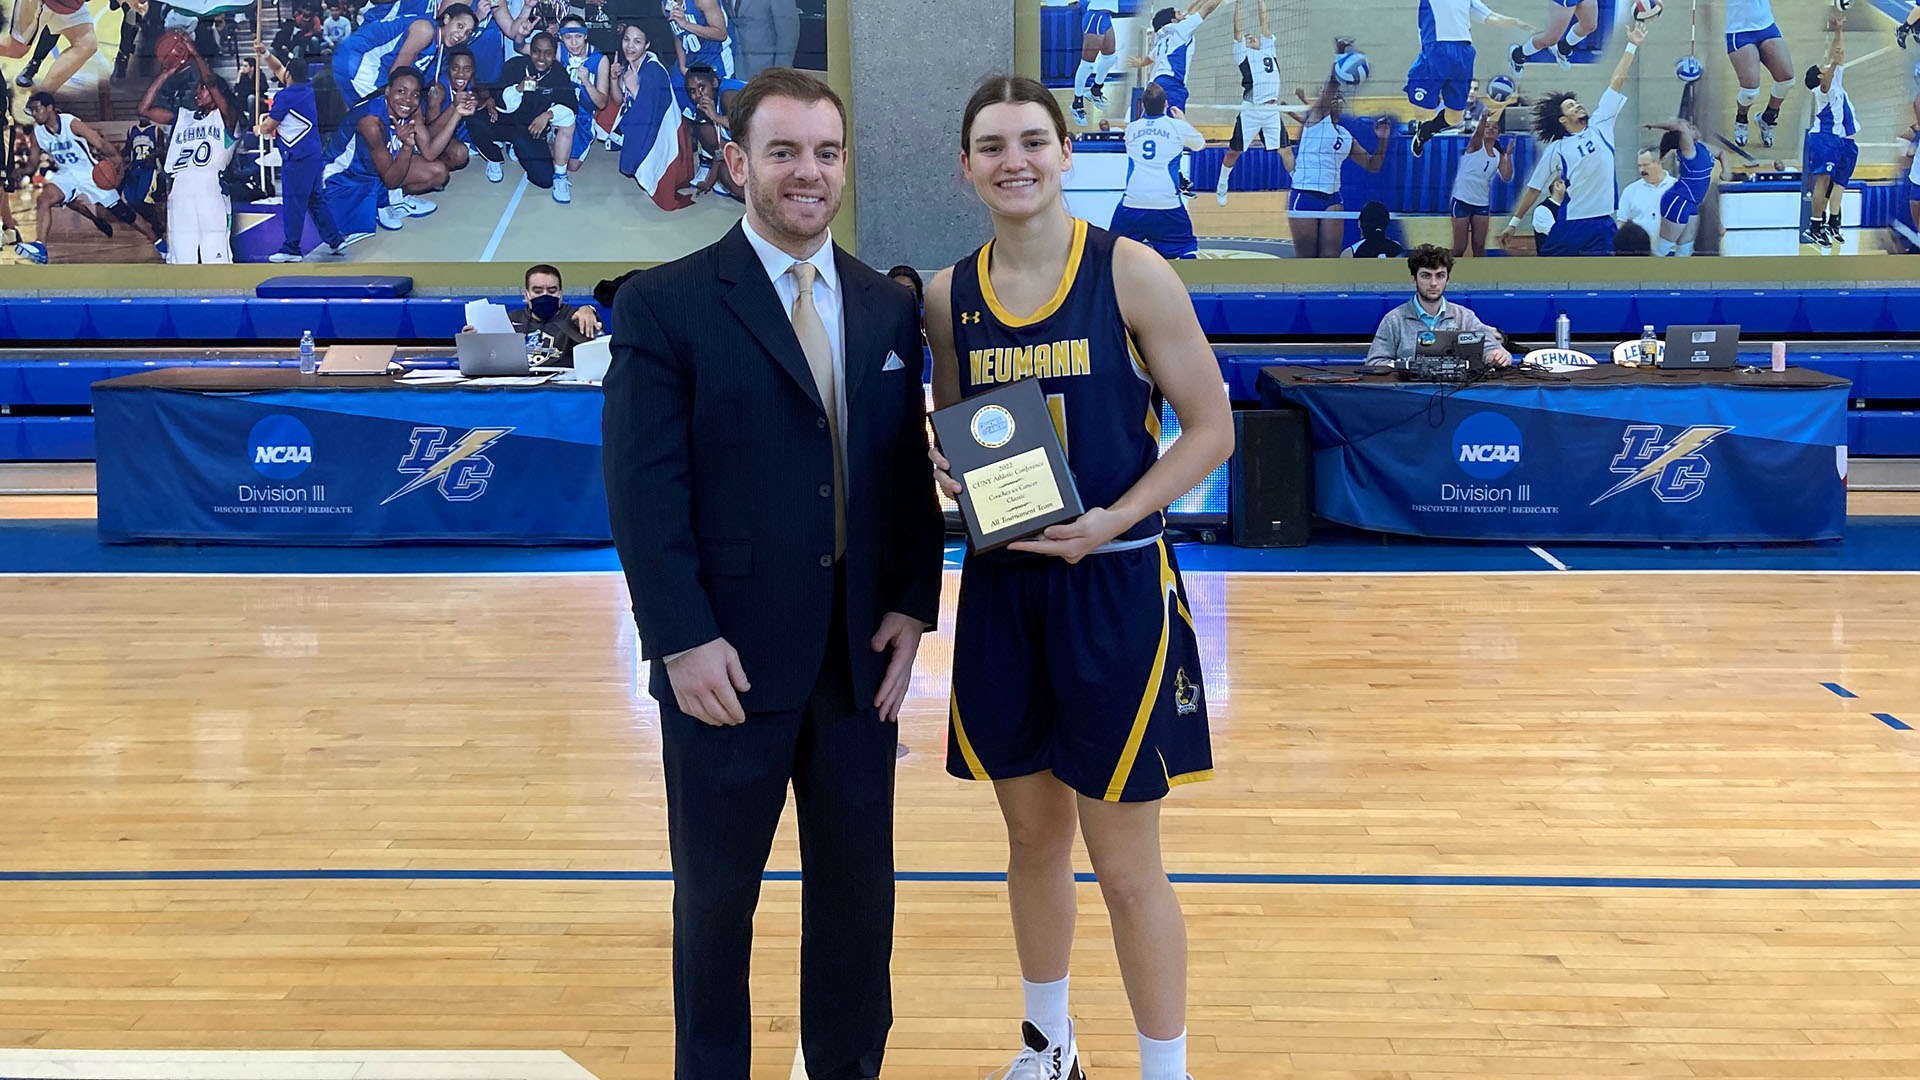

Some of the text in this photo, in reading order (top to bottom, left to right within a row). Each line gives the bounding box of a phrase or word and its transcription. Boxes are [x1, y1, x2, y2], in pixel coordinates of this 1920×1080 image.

[1262, 57, 1275, 73] 9
[176, 125, 221, 144] LEHMAN
[1132, 128, 1170, 141] LEHMAN
[1142, 139, 1156, 160] 9
[1333, 136, 1344, 151] 6
[1576, 140, 1596, 158] 12
[173, 141, 212, 171] 20
[1483, 161, 1490, 172] 1
[968, 338, 1091, 386] NEUMANN
[1534, 352, 1589, 366] LEHMAN
[255, 446, 312, 463] NCAA
[1459, 445, 1520, 463] NCAA
[972, 462, 1044, 489] CUNY Athletic Conference
[239, 485, 325, 502] Division III
[988, 489, 1012, 501] Coaches
[1018, 481, 1038, 491] Cancer
[1006, 494, 1025, 504] Classic
[1441, 483, 1530, 501] Division III
[308, 506, 353, 514] DEDICATE
[990, 502, 1054, 528] All Tournament Team
[1412, 504, 1458, 513] DISCOVER
[1512, 506, 1559, 514] DEDICATE
